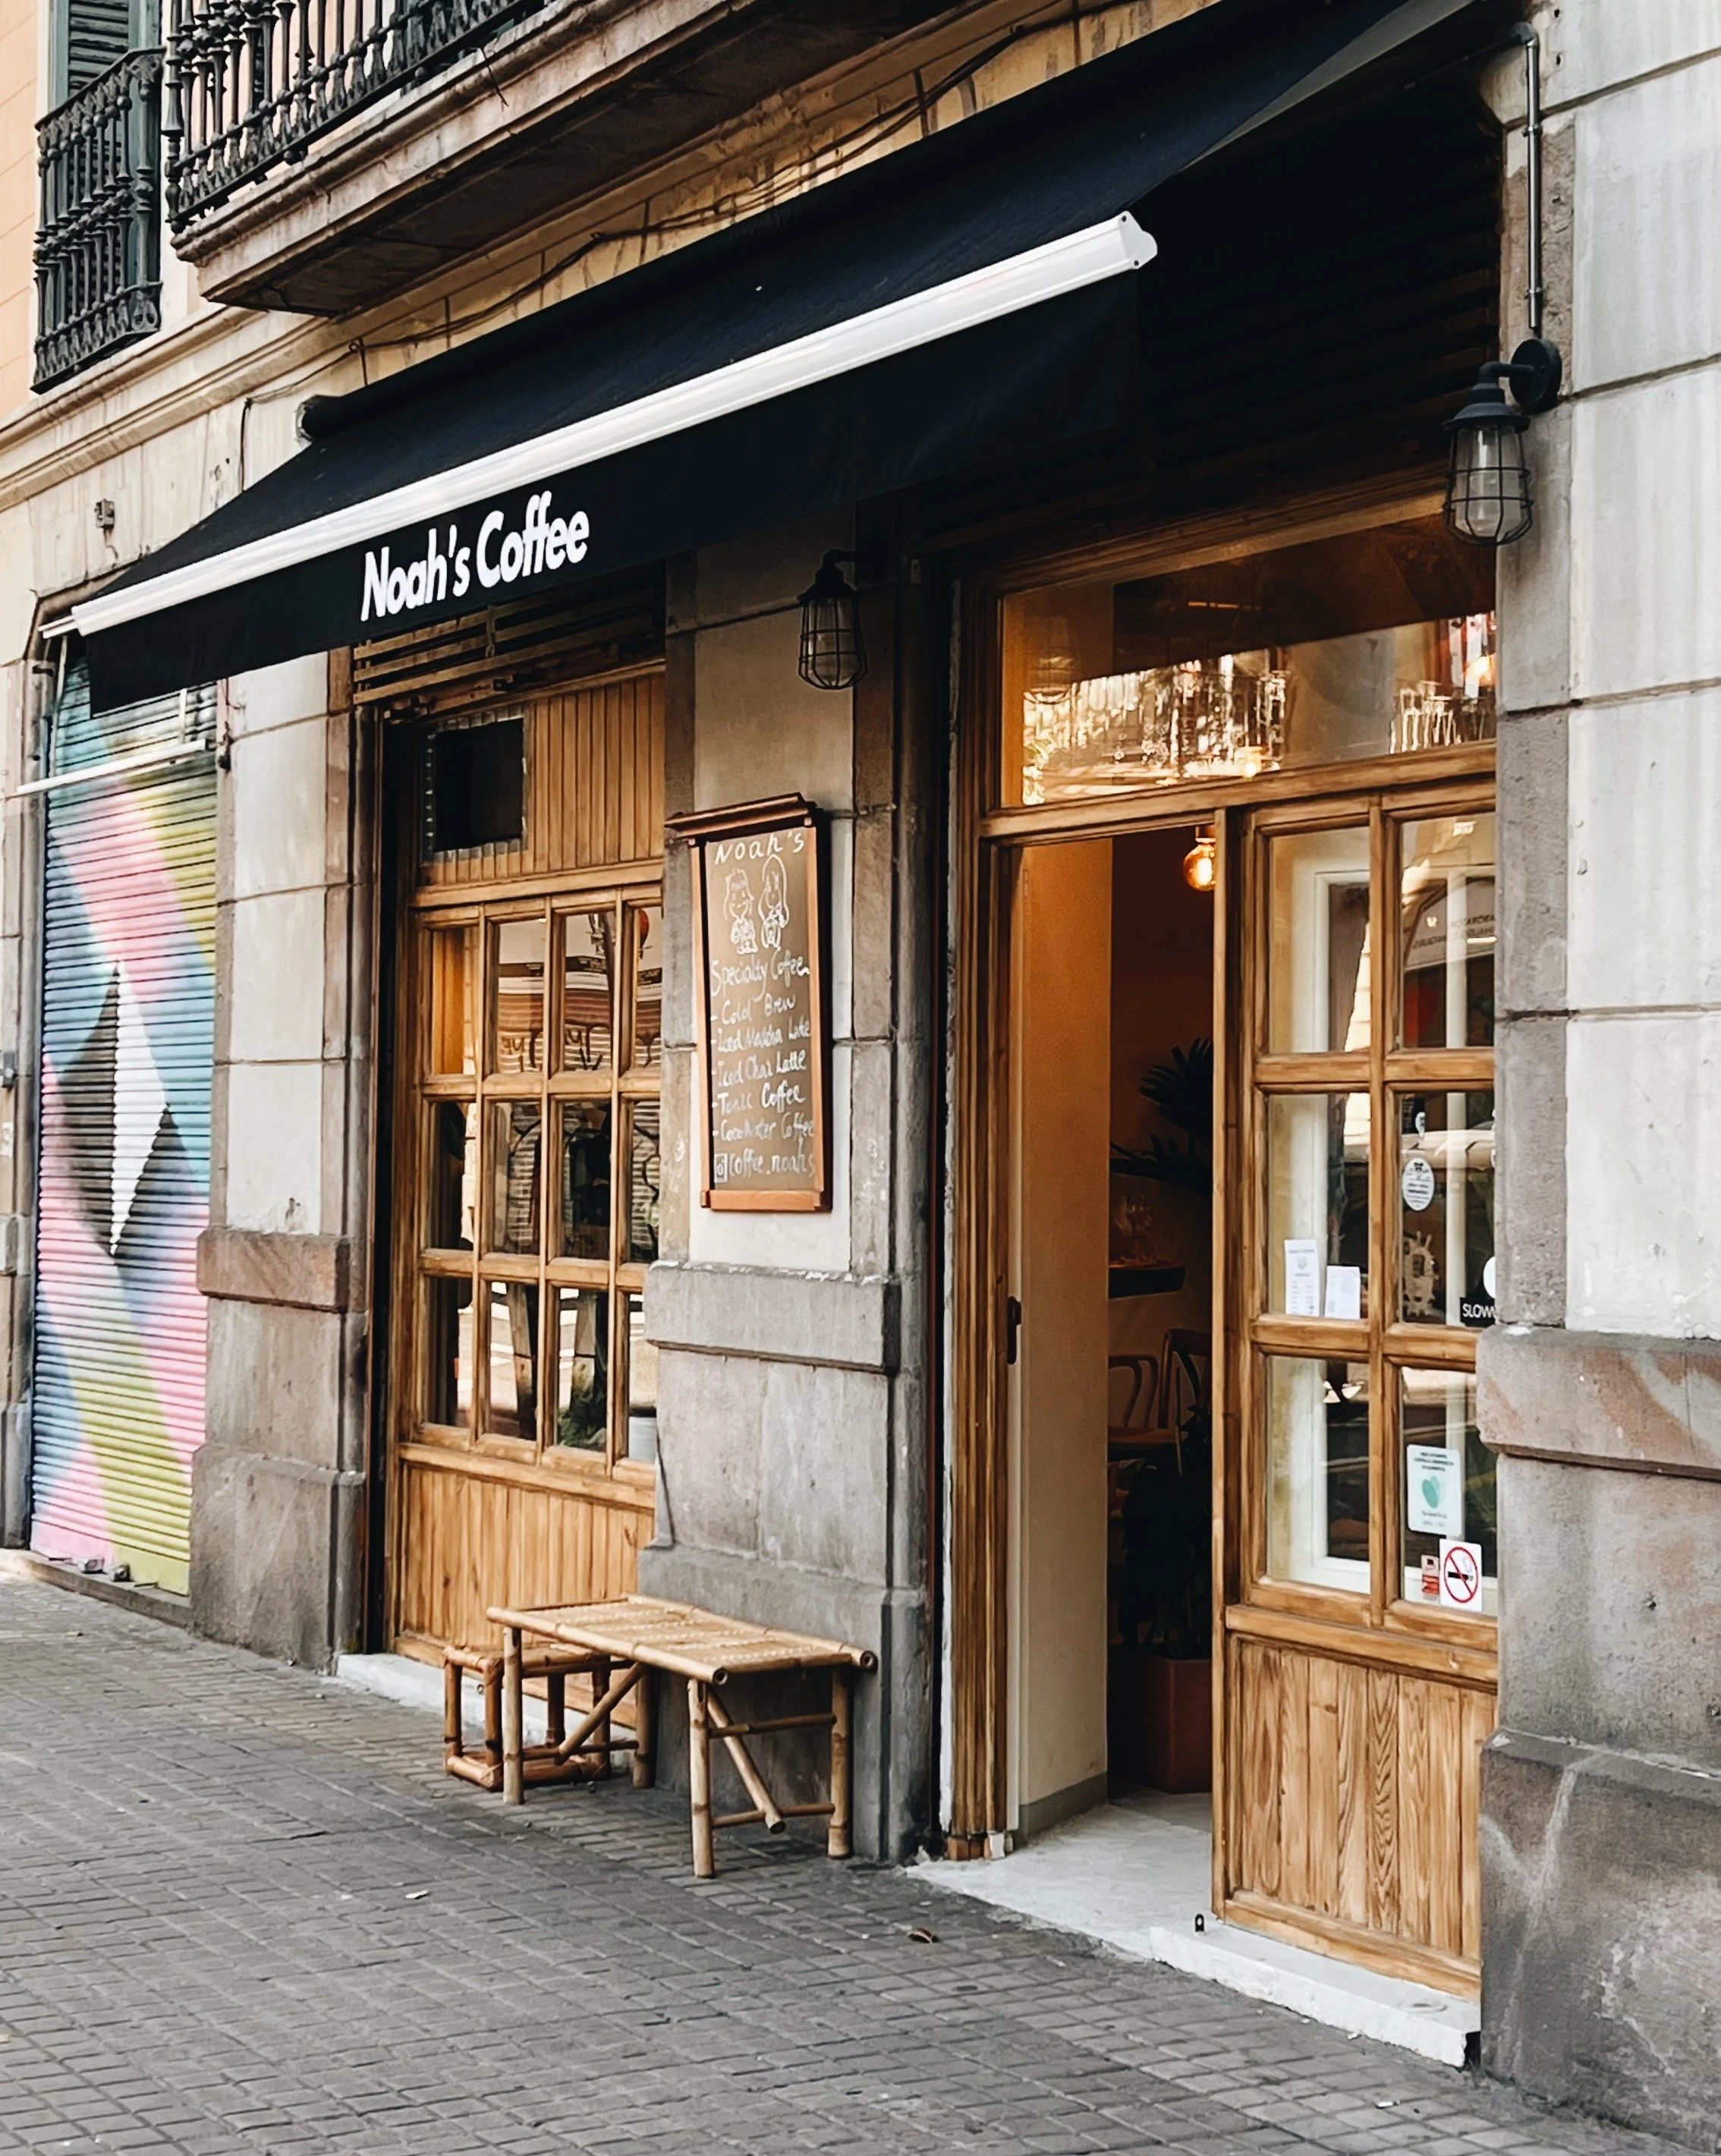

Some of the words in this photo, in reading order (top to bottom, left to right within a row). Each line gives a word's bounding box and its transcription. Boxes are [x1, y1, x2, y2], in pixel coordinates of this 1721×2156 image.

[360, 524, 470, 622] Noah's
[476, 490, 590, 587] Coffee
[714, 831, 805, 865] Noah's
[722, 999, 753, 1024] Cold
[764, 993, 796, 1017] Brew
[717, 1061, 744, 1087] Iced
[776, 1049, 807, 1073] Latte
[761, 1079, 805, 1113] Coffee
